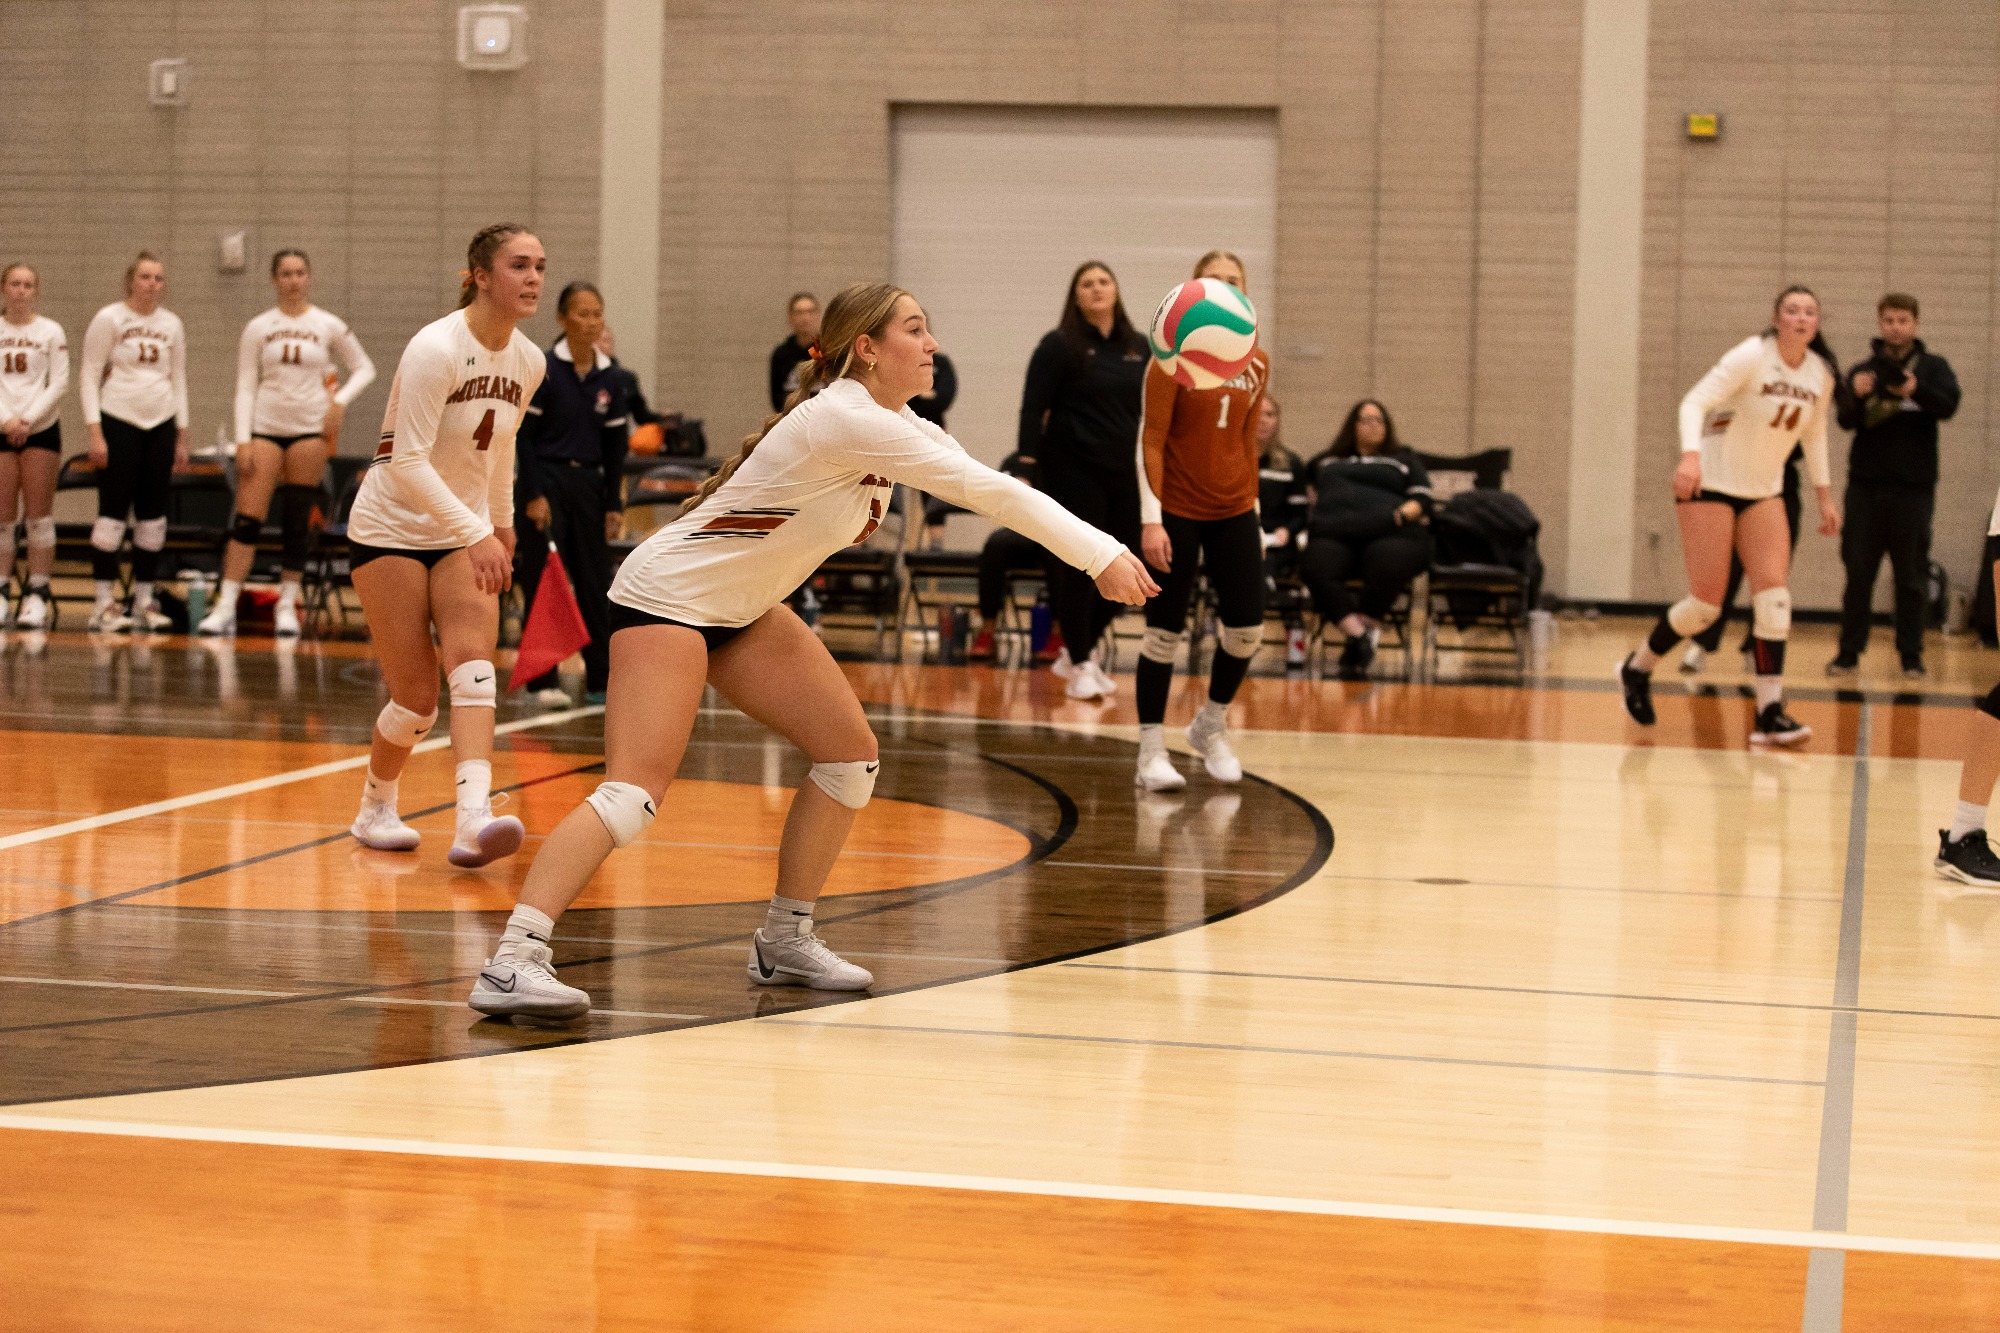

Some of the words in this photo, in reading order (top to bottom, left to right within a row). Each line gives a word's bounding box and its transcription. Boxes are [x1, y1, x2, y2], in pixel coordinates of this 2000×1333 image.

[139, 342, 159, 364] 13
[281, 344, 302, 365] 11
[1217, 394, 1231, 428] 1
[472, 408, 496, 451] 4
